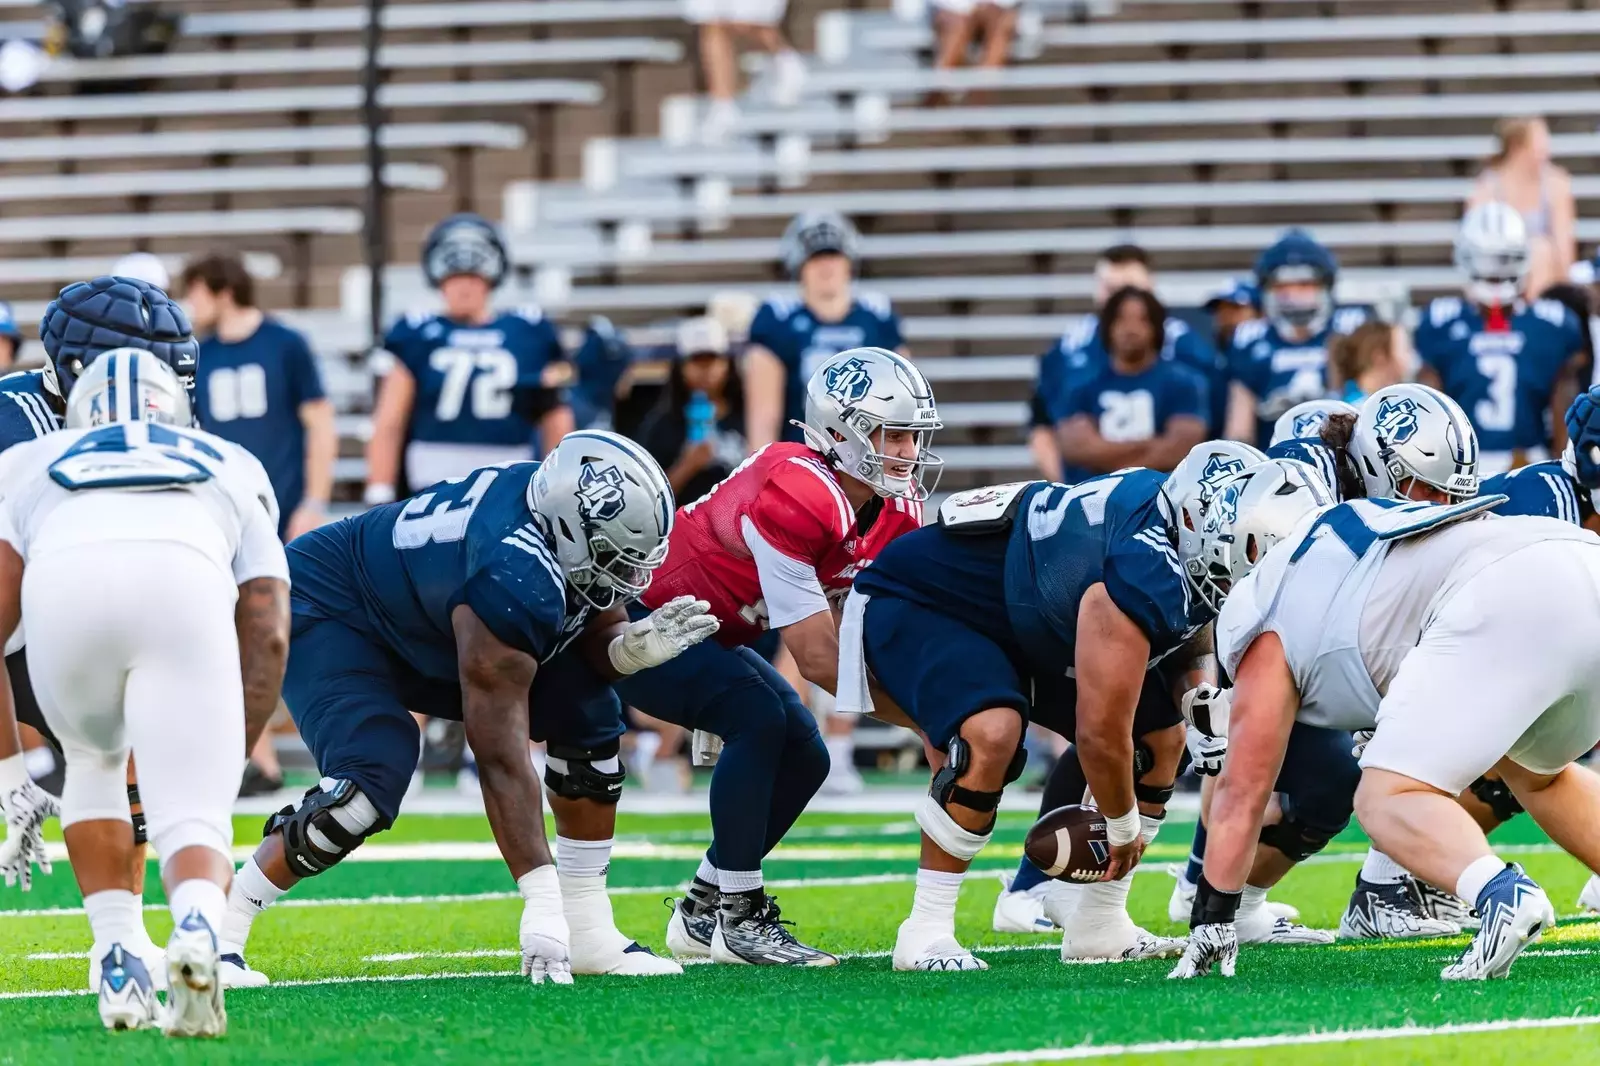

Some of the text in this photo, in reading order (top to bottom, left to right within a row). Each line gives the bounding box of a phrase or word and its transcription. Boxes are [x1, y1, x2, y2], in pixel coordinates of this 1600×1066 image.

[429, 347, 518, 421] 72
[1474, 354, 1518, 431] 3
[920, 409, 936, 420] RICE
[1454, 477, 1473, 487] RICE
